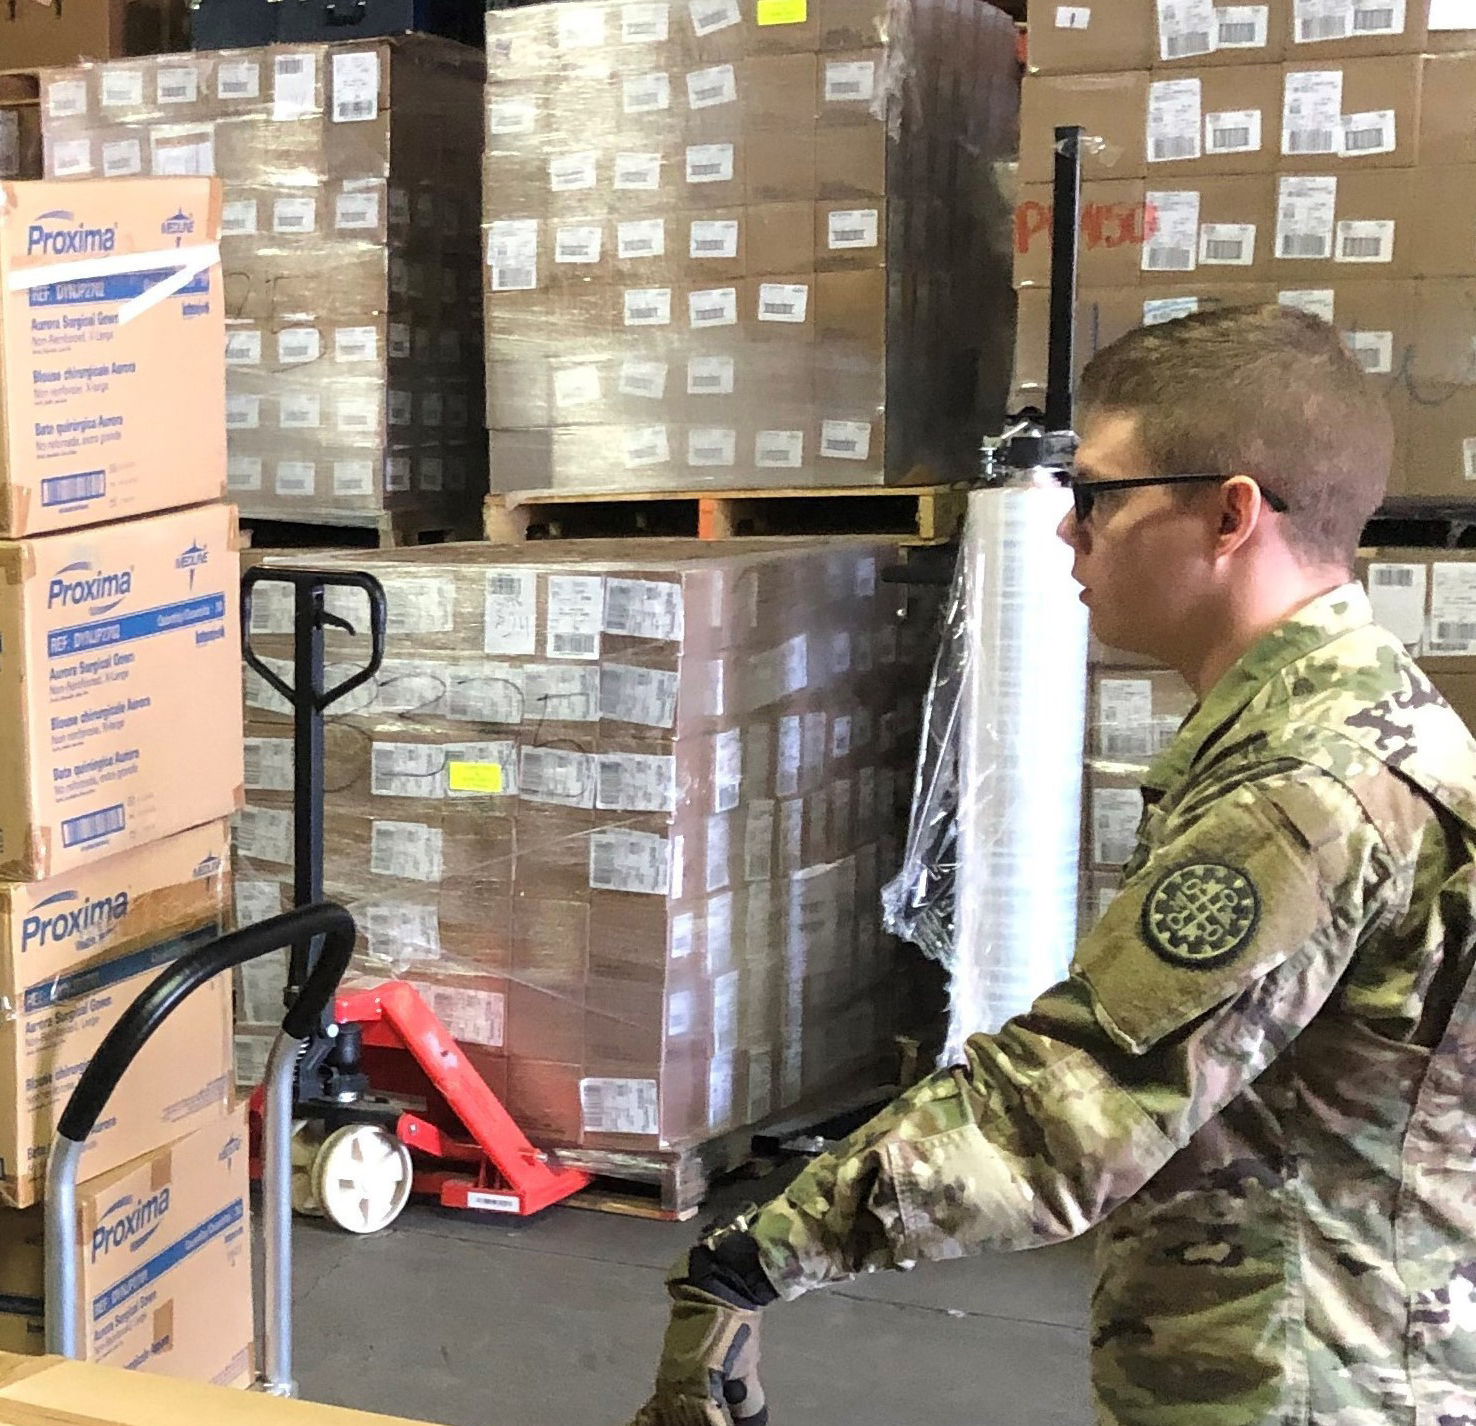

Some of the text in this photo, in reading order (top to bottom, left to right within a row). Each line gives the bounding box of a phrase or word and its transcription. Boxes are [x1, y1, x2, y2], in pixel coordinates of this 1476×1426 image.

[26, 222, 115, 256] Proxima
[47, 564, 132, 610] Proxima
[22, 890, 129, 953] Proxima
[91, 1187, 170, 1263] Proxima
